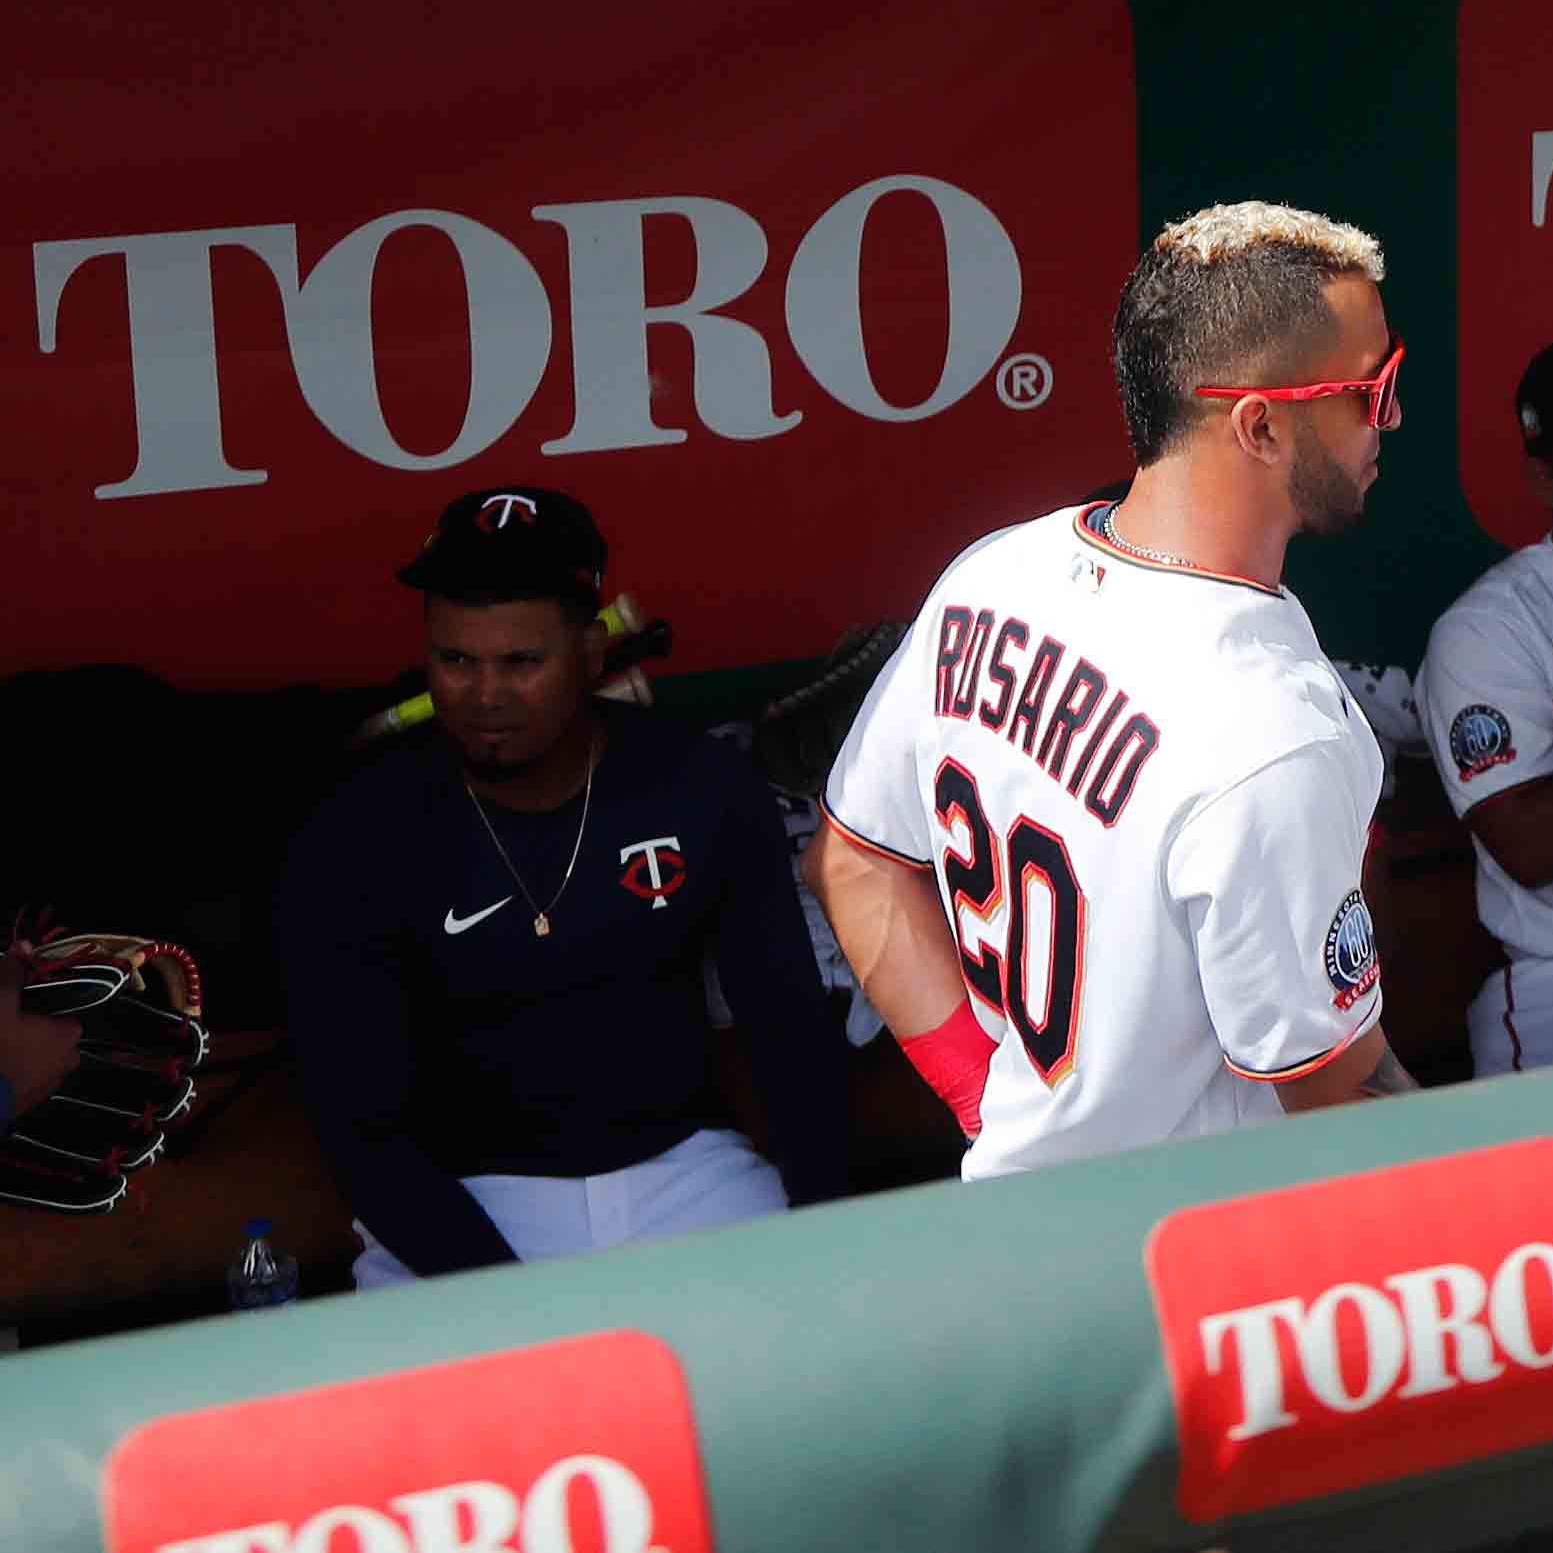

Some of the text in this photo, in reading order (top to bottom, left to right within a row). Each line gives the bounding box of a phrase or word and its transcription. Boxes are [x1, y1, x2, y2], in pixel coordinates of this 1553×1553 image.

[33, 172, 1023, 500] TORO
[933, 604, 1162, 830] ROSARIO
[933, 754, 1090, 1091] 20
[155, 1454, 654, 1553] RO
